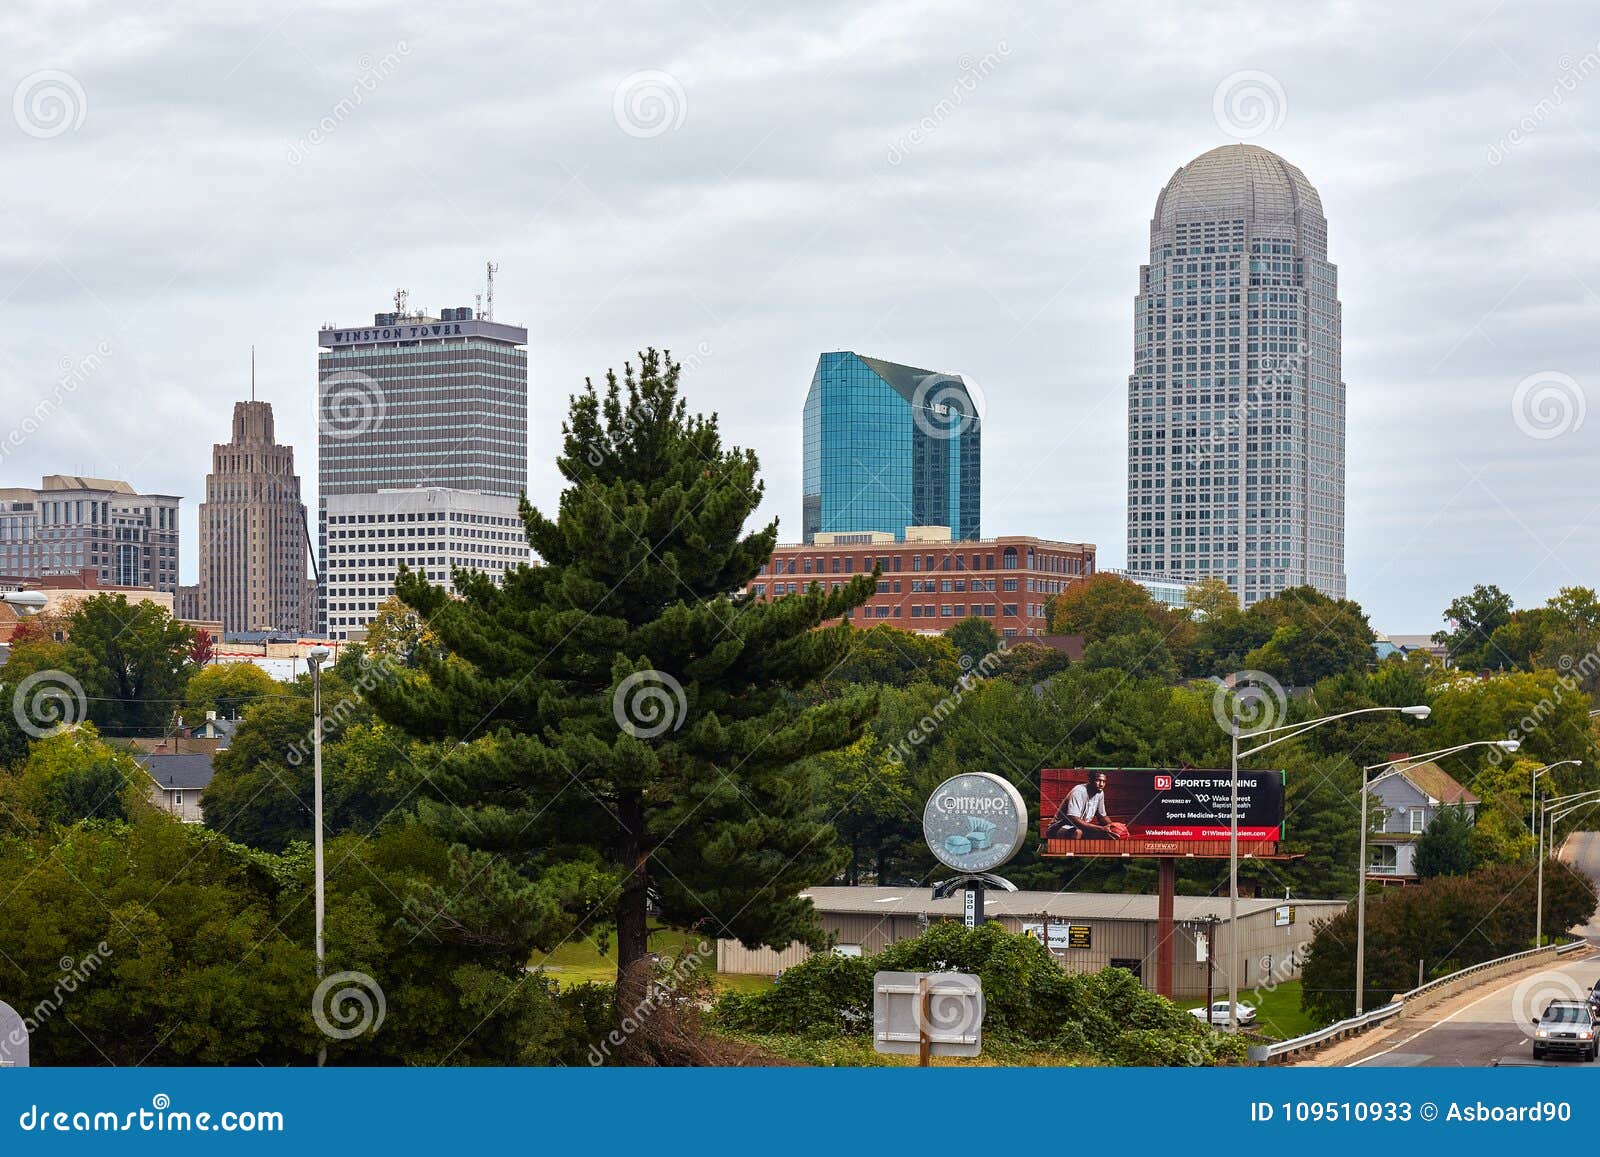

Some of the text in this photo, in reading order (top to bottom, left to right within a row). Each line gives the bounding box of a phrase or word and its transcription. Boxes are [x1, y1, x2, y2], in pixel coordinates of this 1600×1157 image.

[334, 324, 462, 342] WINSTON TOWER
[1157, 777, 1169, 788] D1
[1174, 779, 1211, 788] SPORTS
[1166, 812, 1186, 820] Sports
